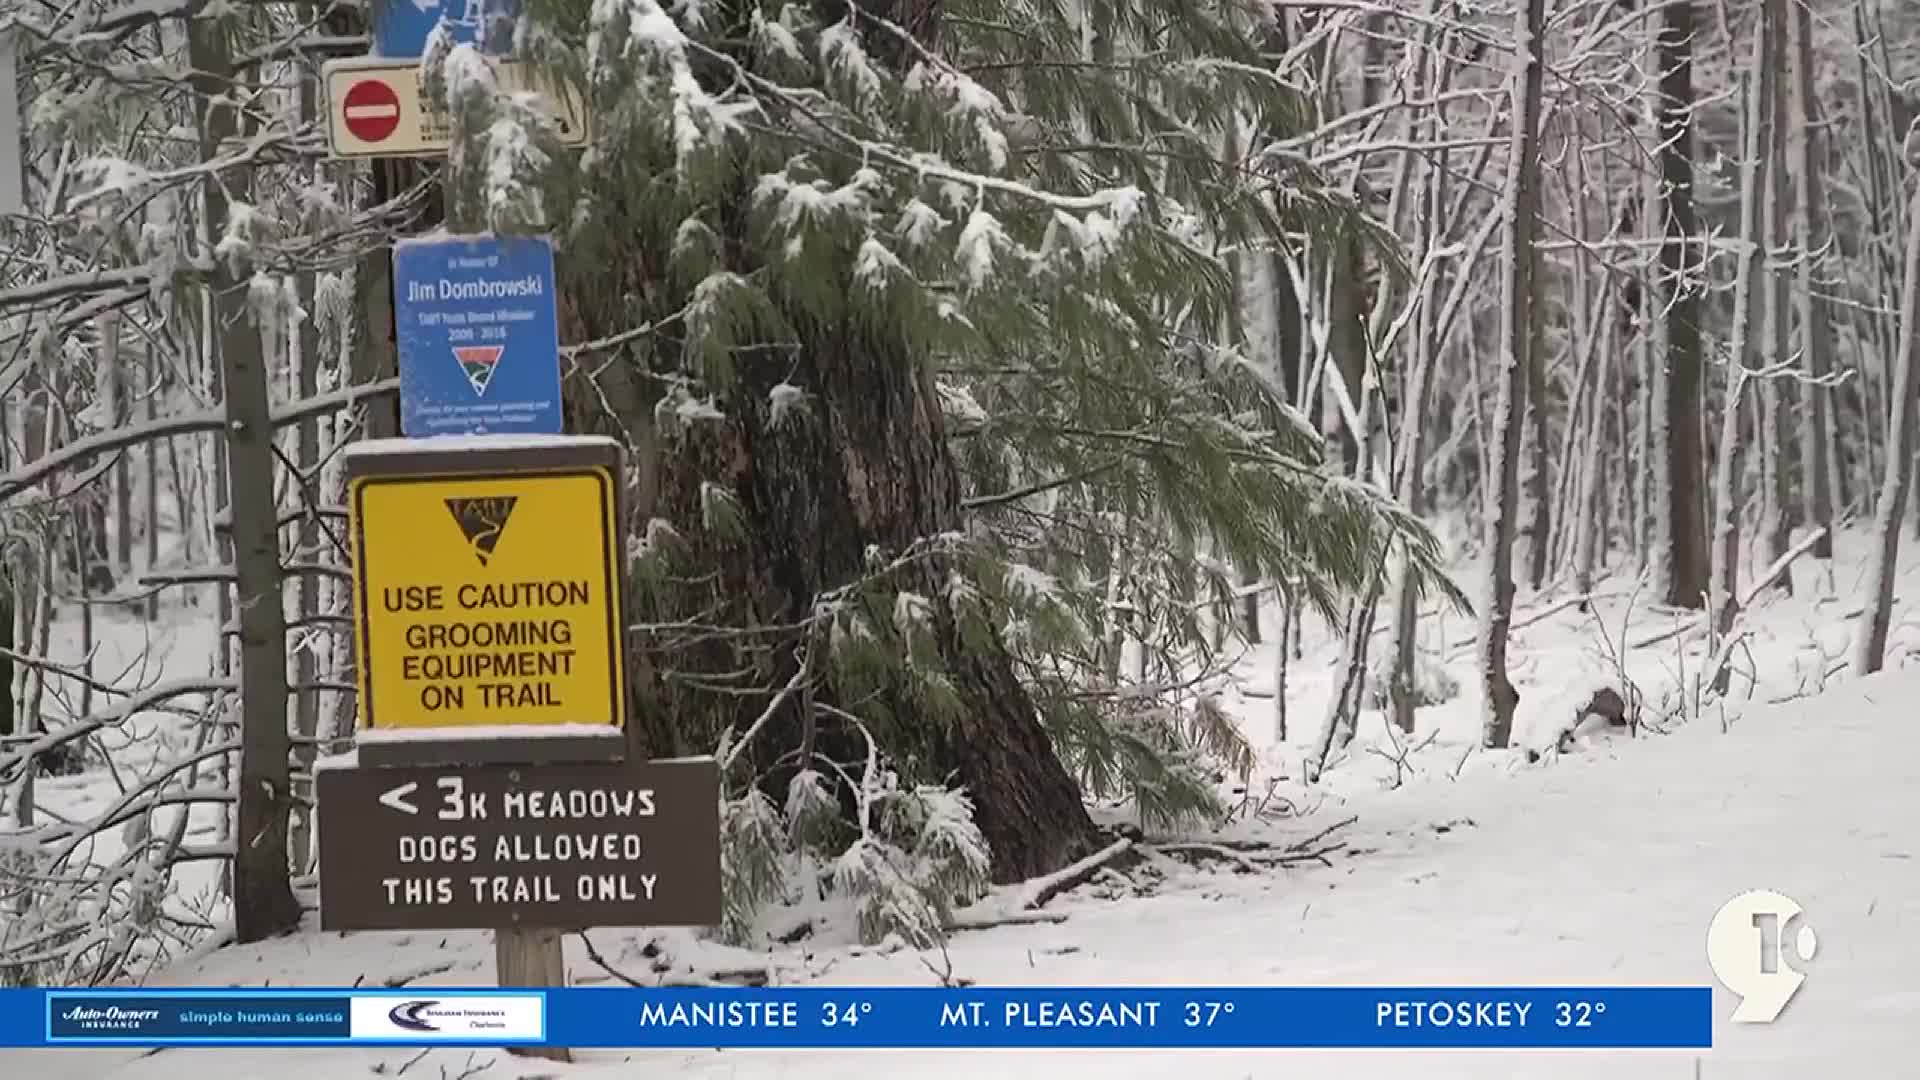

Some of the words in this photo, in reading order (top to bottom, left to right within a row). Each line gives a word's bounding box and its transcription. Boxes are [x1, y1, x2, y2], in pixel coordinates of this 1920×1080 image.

[408, 279, 435, 301] Jim
[439, 275, 542, 300] Dombrowski
[384, 586, 444, 612] USE
[457, 580, 589, 609] CAUTION
[405, 620, 571, 649] GROOMING
[403, 651, 576, 681] EQUIPMENT
[421, 685, 464, 711] ON
[477, 682, 561, 709] TRAIL
[504, 789, 656, 818] MEADOWS
[400, 835, 477, 862] DOGS
[495, 834, 640, 861] ALLOWED
[382, 877, 453, 904] THIS
[470, 875, 560, 903] TRAIL
[577, 874, 657, 901] ONLY
